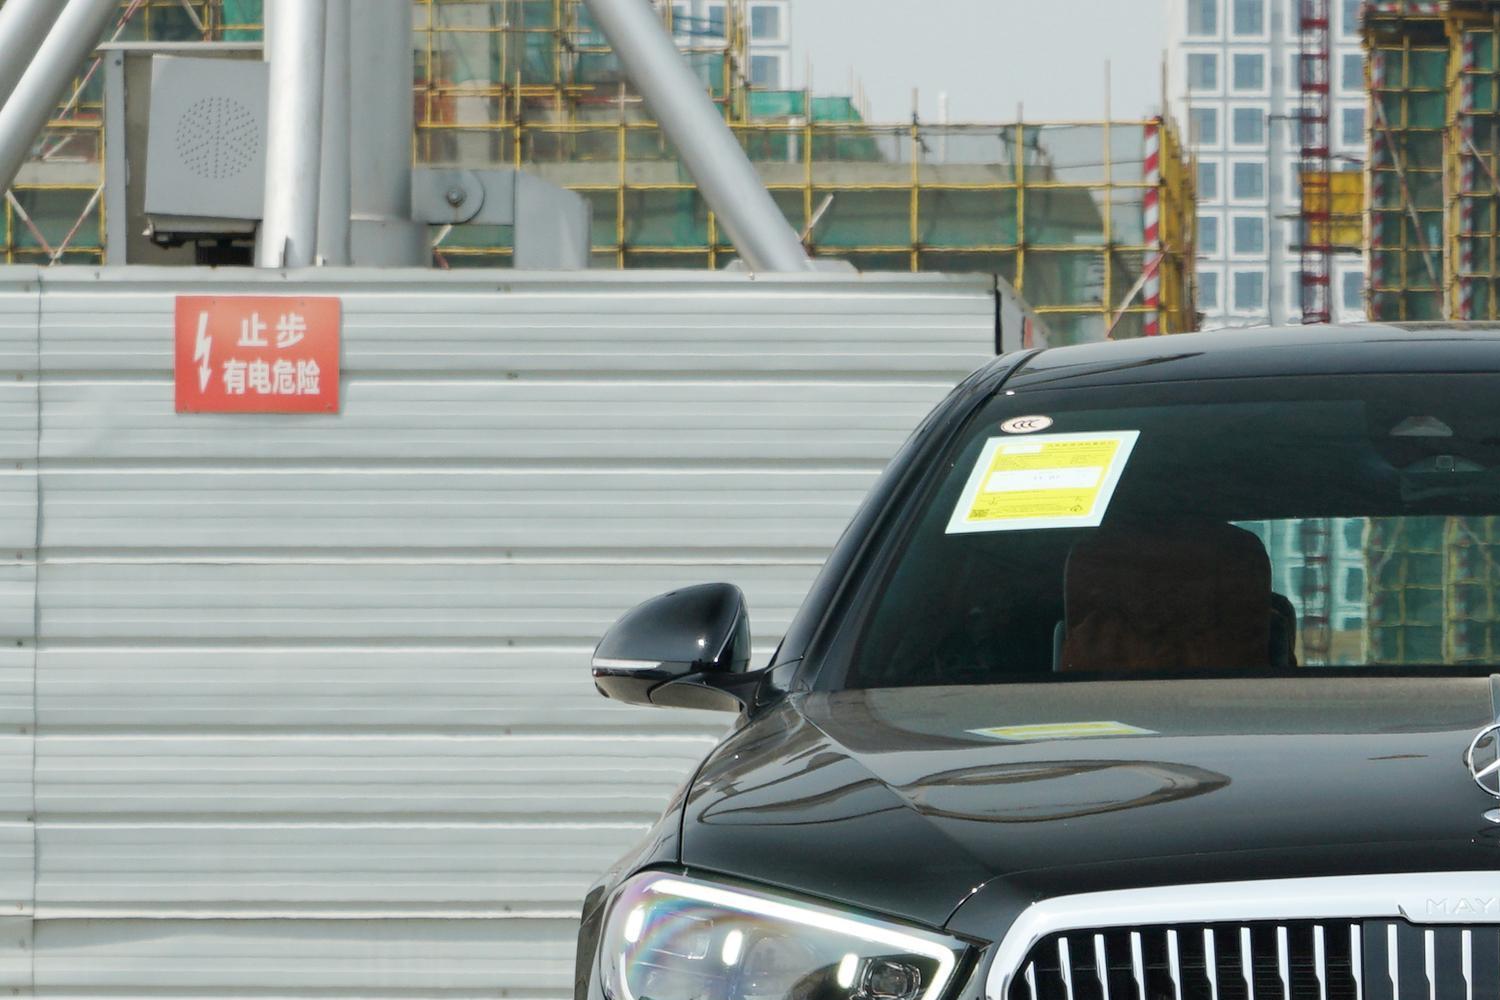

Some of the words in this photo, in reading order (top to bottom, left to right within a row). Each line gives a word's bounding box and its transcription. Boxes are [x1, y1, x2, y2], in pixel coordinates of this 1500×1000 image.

[237, 312, 307, 348] 止步
[223, 358, 320, 395] 有电危险
